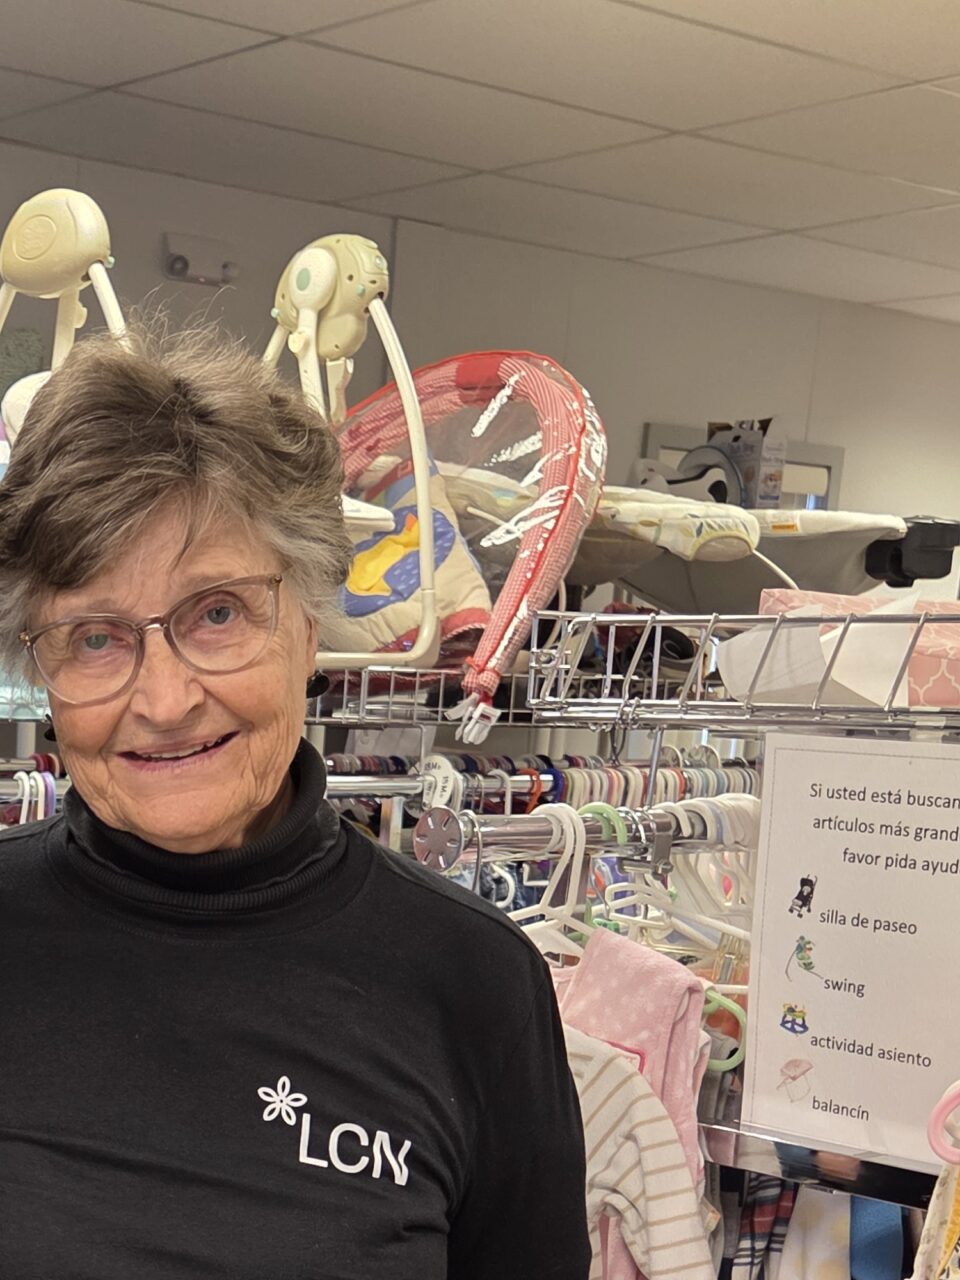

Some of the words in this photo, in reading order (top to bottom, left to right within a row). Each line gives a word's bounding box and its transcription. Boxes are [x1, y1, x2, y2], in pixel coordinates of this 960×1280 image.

[809, 783, 823, 798] Si
[826, 786, 867, 801] usted
[871, 788, 902, 804] está
[813, 815, 875, 834] artículos
[879, 820, 910, 838] más
[914, 826, 960, 842] grand
[842, 847, 881, 866] favor
[885, 853, 917, 870] pida
[921, 858, 960, 876] ayud
[819, 909, 847, 926] silla
[851, 912, 869, 928] de
[873, 919, 918, 935] paseo
[823, 977, 865, 998] swing
[810, 1035, 874, 1057] actividad
[877, 1047, 932, 1068] asiento
[811, 1095, 870, 1121] balancín
[298, 1112, 413, 1187] LCN
